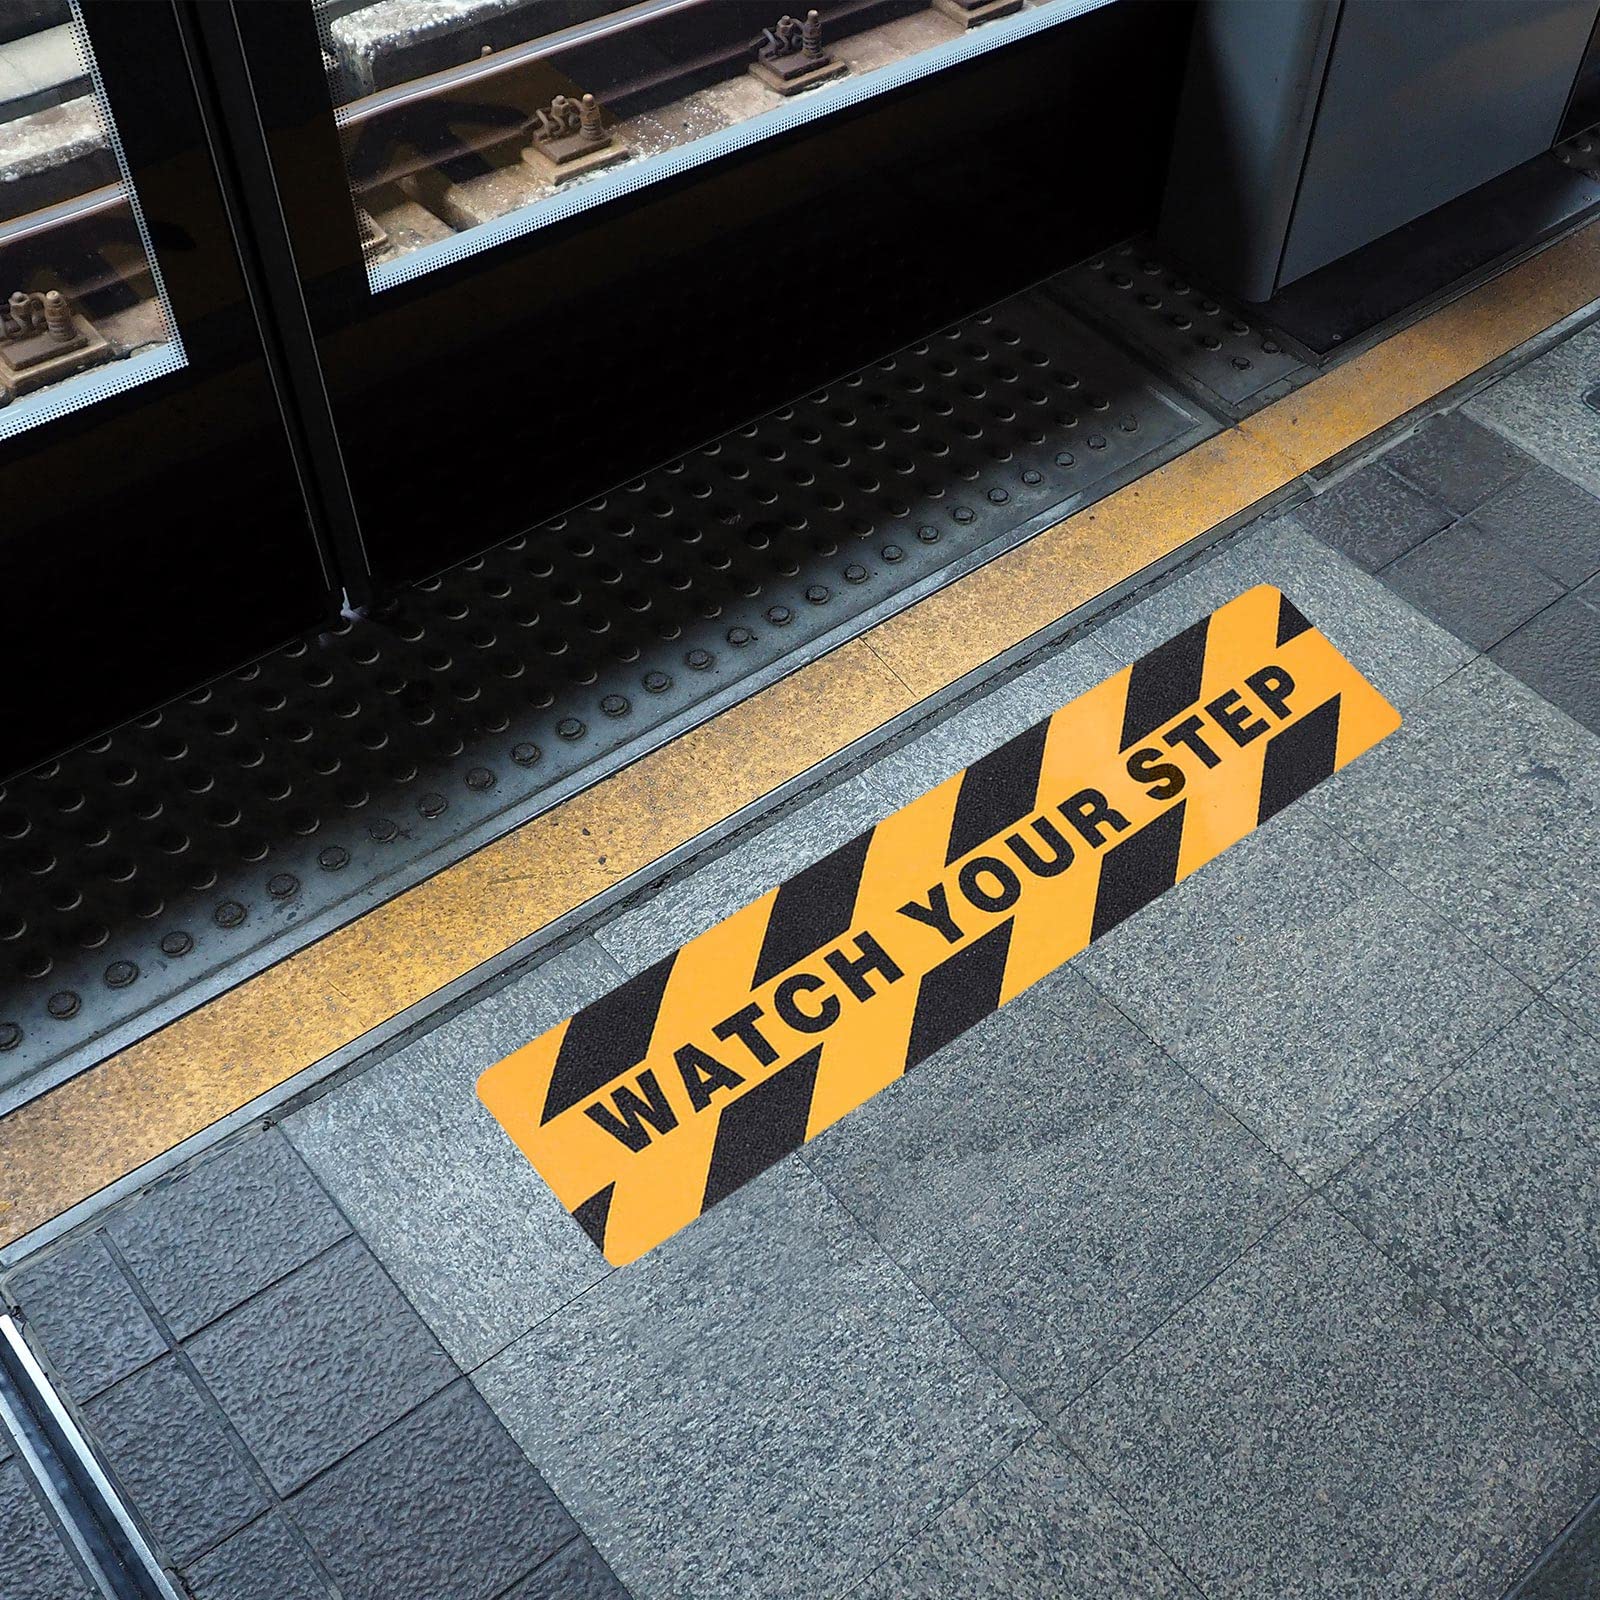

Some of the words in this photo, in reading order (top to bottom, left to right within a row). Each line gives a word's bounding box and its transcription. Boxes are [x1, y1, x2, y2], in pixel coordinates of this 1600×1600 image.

[584, 931, 905, 1153] WATCH
[896, 787, 1132, 965] YOUR
[1126, 665, 1296, 801] STEP
